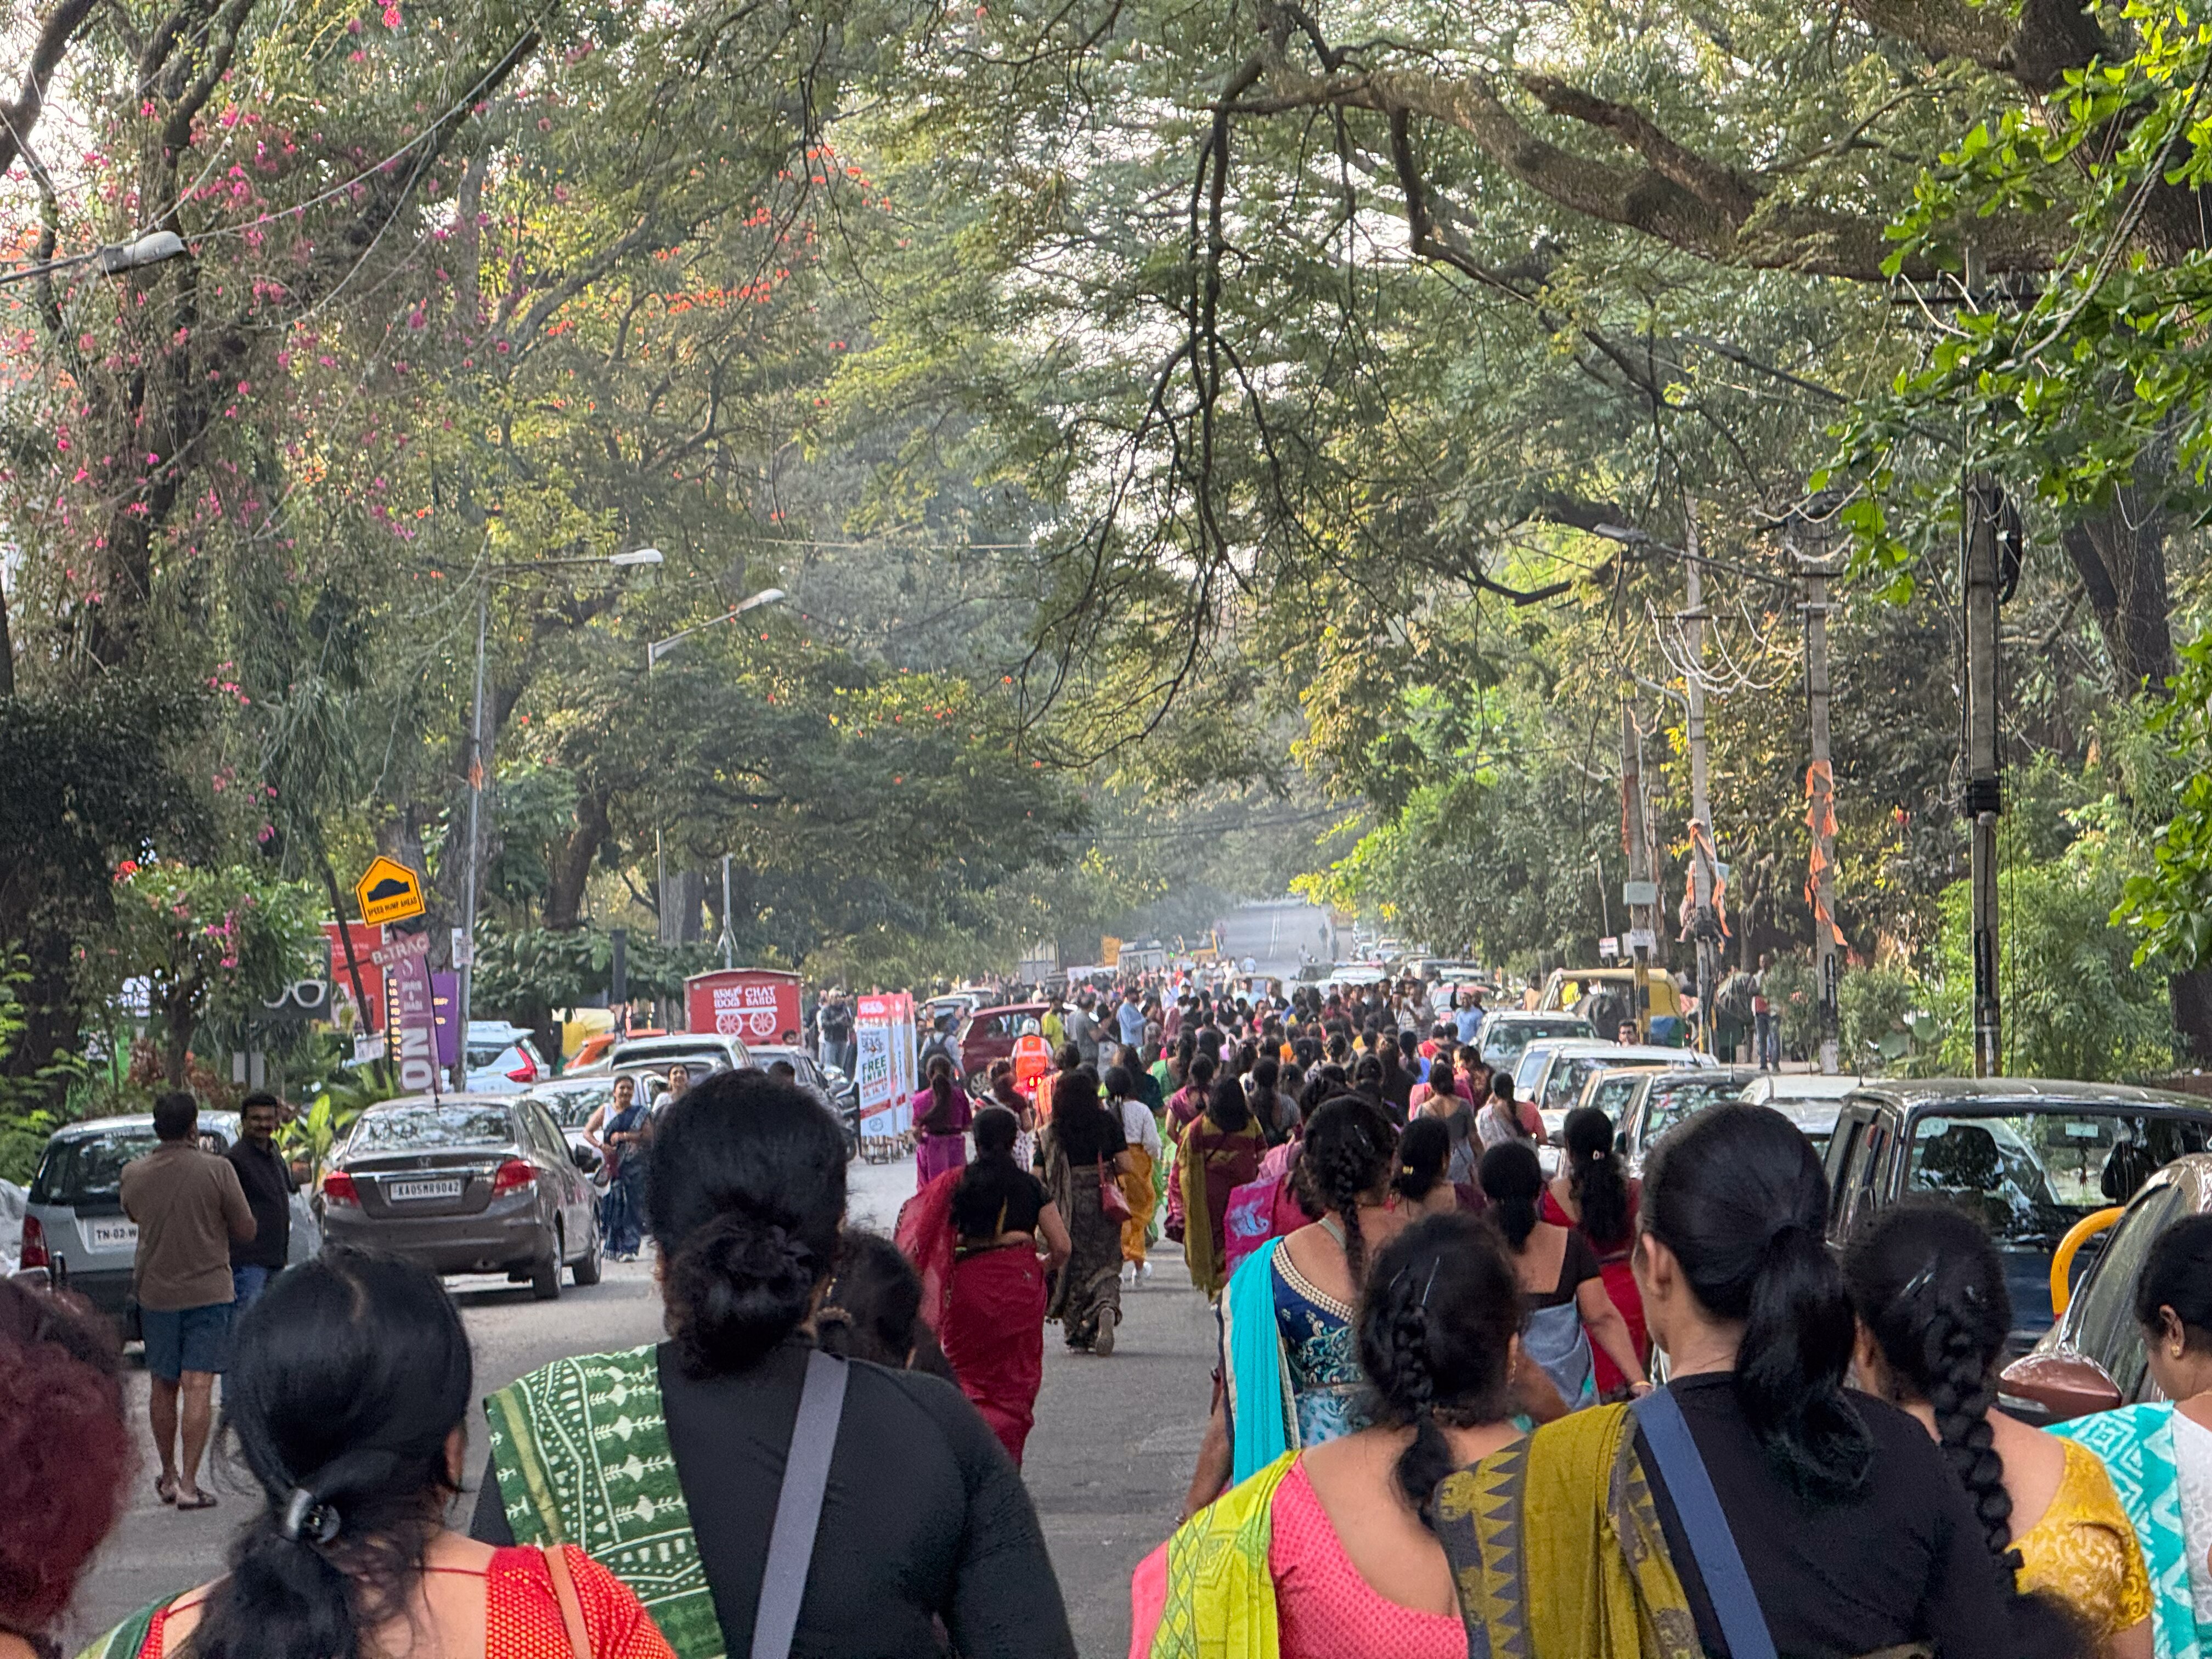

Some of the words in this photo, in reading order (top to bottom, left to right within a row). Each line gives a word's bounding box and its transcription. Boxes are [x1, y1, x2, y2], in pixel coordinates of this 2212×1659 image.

[367, 906, 384, 917] SPEED
[400, 896, 417, 908] AHEAD
[745, 985, 776, 998] CHAT
[862, 1054, 887, 1071] FREE
[862, 1068, 887, 1084] ENTRY
